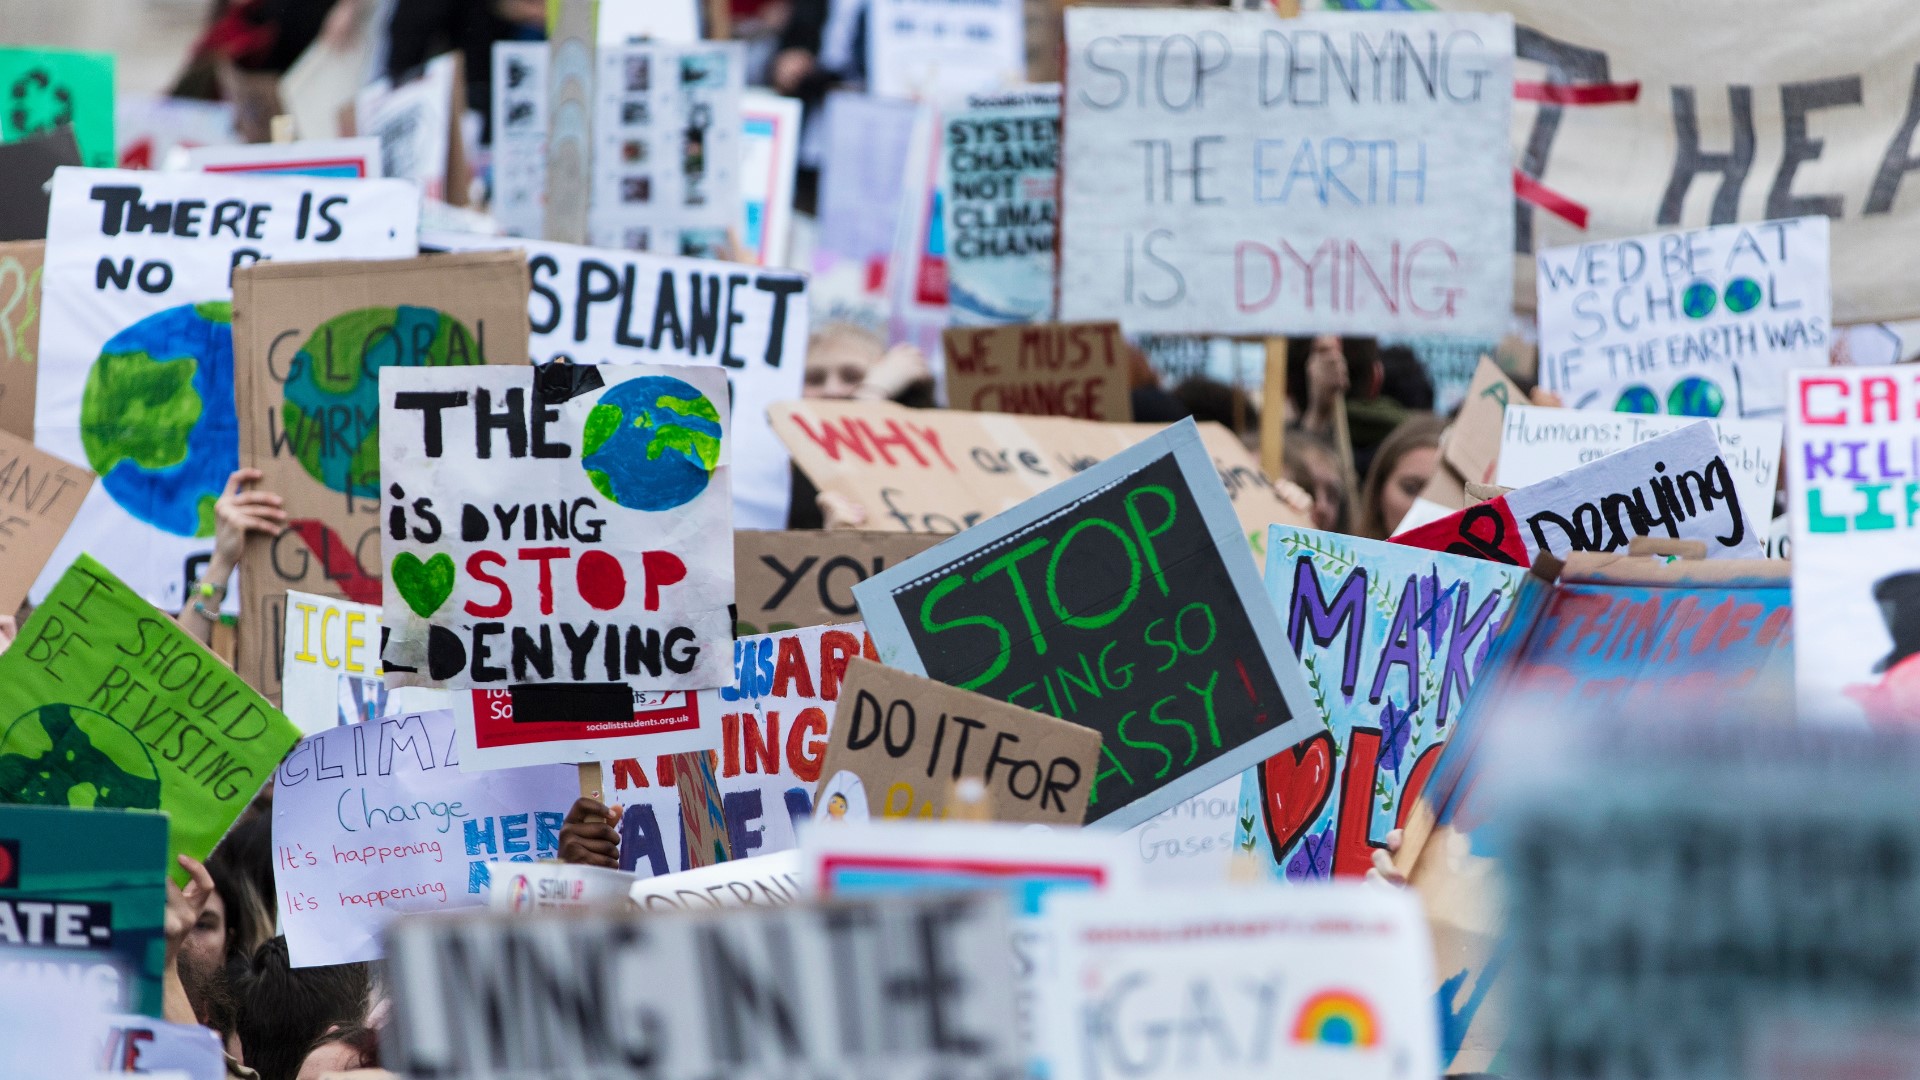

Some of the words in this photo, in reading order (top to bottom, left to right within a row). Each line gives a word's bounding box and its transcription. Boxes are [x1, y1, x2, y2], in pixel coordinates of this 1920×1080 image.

[1078, 30, 1232, 113] STOP
[1258, 29, 1494, 108] DENYING
[952, 177, 1014, 201] NOT
[1132, 135, 1227, 206] THE
[1252, 136, 1429, 207] EARTH
[90, 186, 272, 239] THERE
[295, 190, 349, 243] IS
[1725, 217, 1801, 272] AT
[95, 256, 174, 294] NO
[1123, 228, 1187, 309] IS
[1234, 237, 1467, 319] DYING
[573, 260, 805, 369] PLANET
[944, 330, 999, 375] WE
[1019, 324, 1118, 371] MUST
[1546, 346, 1584, 394] IF
[1601, 335, 1663, 382] THE
[1664, 322, 1759, 370] EARTH
[1763, 318, 1827, 356] WAS
[394, 386, 573, 460] THE
[790, 412, 958, 472] WHY
[971, 446, 1051, 476] are
[1504, 410, 1623, 444] Humans:
[461, 496, 607, 544] DYING
[463, 547, 688, 619] STOP
[758, 554, 885, 616] YO
[920, 483, 1177, 692] STOP
[59, 567, 114, 624] I
[116, 616, 268, 742] SHOULD
[428, 620, 701, 683] DENYING
[1144, 601, 1217, 673] SO
[24, 614, 93, 683] BE
[88, 665, 254, 802] REVISING
[586, 713, 690, 732] socialiststudents.org.uk
[279, 714, 460, 788] CLIM
[846, 688, 917, 759] DO
[926, 712, 988, 785] IT
[984, 731, 1082, 813] FOR
[336, 787, 470, 834] Change
[279, 842, 318, 871] It's
[331, 839, 444, 867] happening
[285, 890, 320, 915] It's
[339, 880, 448, 909] happening
